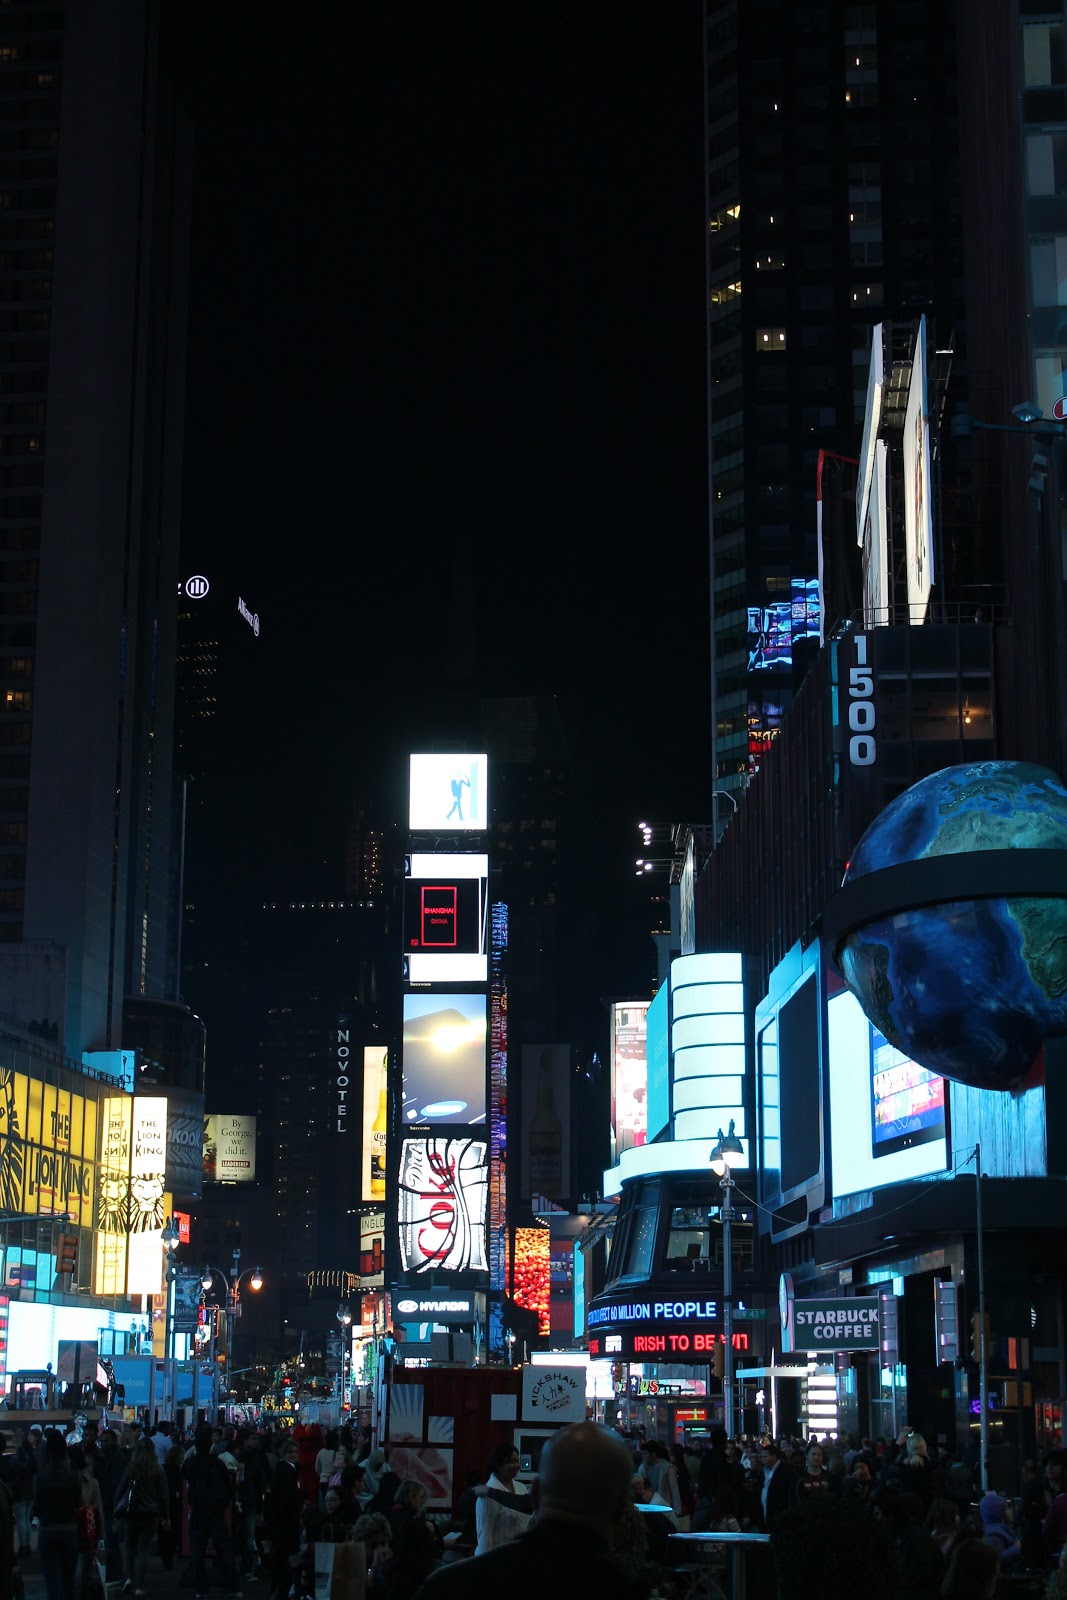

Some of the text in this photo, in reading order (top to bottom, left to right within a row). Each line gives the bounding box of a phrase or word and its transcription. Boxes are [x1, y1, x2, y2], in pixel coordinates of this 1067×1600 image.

[848, 635, 876, 766] 1500
[337, 1029, 350, 1133] NOVOTEL
[50, 1110, 70, 1140] THE
[140, 1120, 158, 1128] THE
[232, 1119, 242, 1129] By
[137, 1130, 161, 1142] LION
[221, 1128, 252, 1138] George,
[135, 1145, 163, 1157] KING
[225, 1146, 247, 1155] did it.
[28, 1137, 91, 1203] LION KING
[405, 1145, 423, 1188] Diet
[418, 1152, 456, 1260] Coke
[419, 1301, 470, 1312] HYUNDAI
[610, 1306, 618, 1321] 60
[618, 1303, 651, 1320] MILLION
[654, 1301, 717, 1318] PEOPLE
[749, 1310, 759, 1319] 43
[796, 1308, 879, 1325] STARBUCK
[813, 1325, 873, 1339] COFFEE
[634, 1336, 666, 1352] IRISH
[669, 1335, 690, 1351] TO
[693, 1334, 716, 1351] BE
[531, 1373, 579, 1407] RICKSHAW
[548, 1399, 571, 1412] TRUCK
